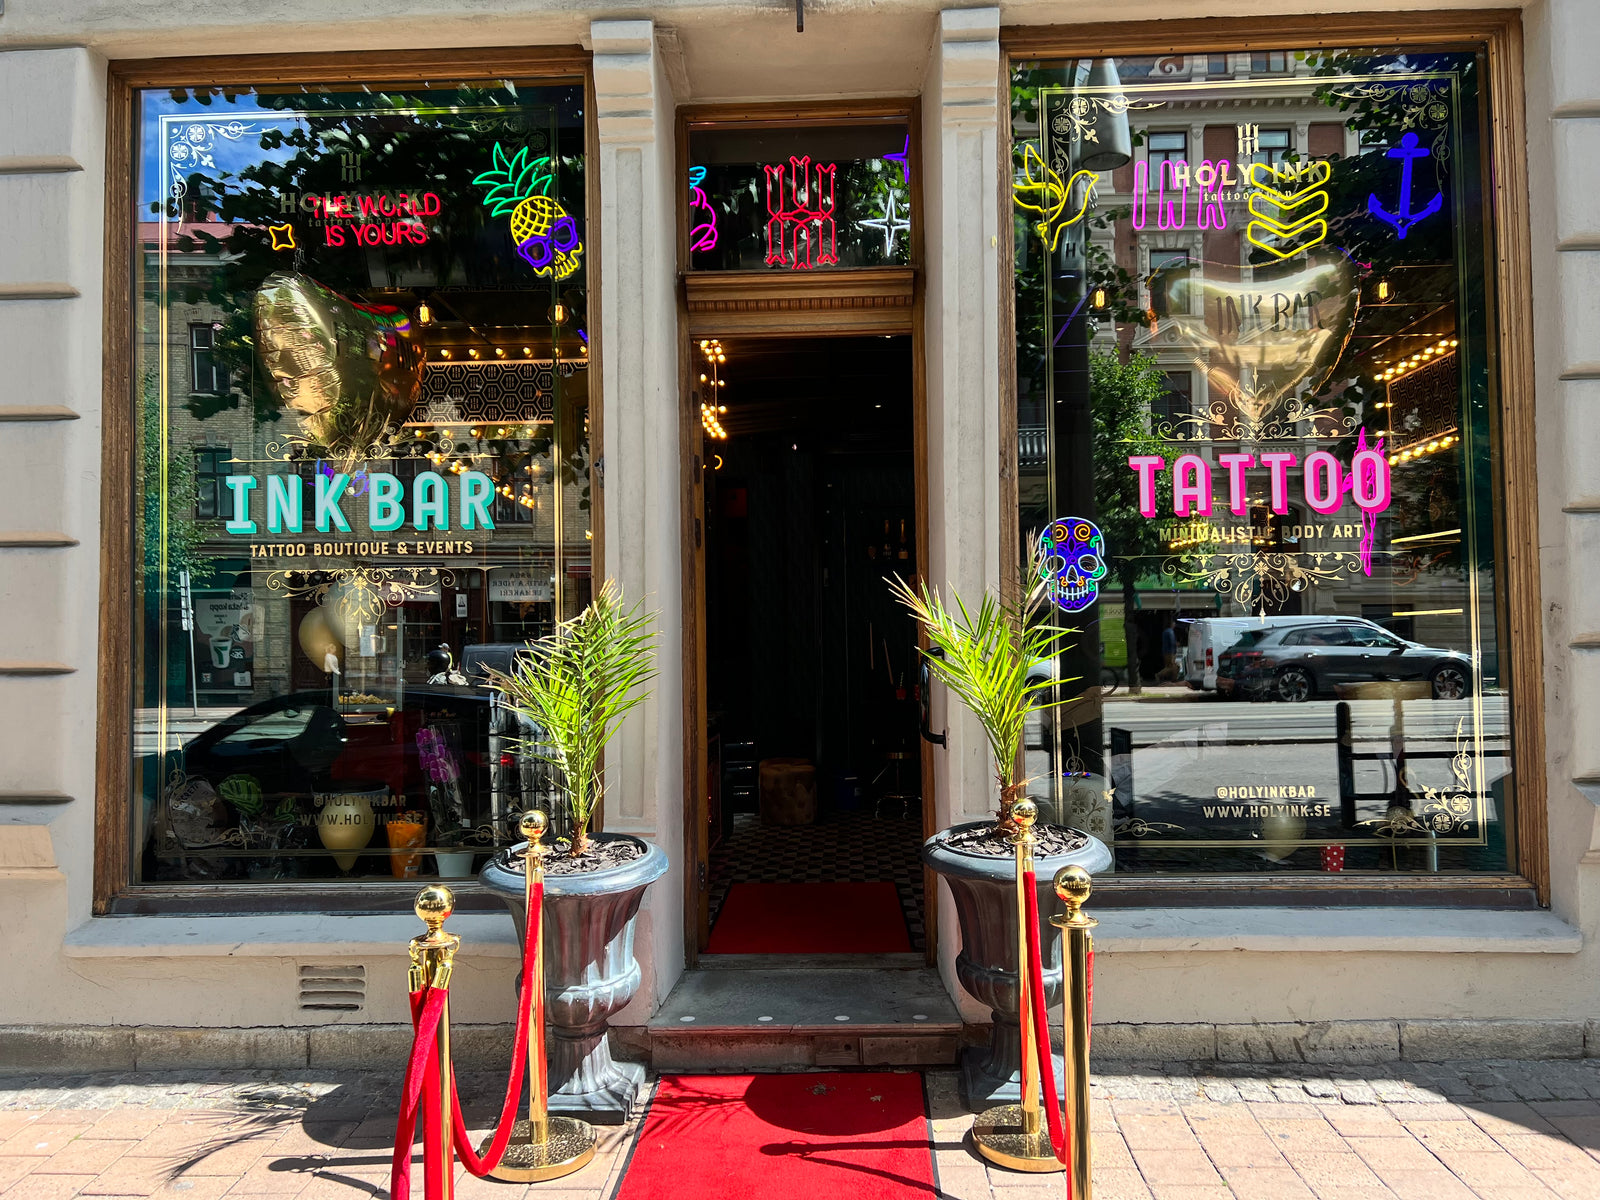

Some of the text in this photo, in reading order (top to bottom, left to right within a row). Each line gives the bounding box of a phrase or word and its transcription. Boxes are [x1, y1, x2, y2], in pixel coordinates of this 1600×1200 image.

[1174, 160, 1325, 188] HOLY INK
[307, 192, 441, 219] THE WORLD
[1133, 159, 1230, 230] INK
[1203, 190, 1250, 202] tattoo
[308, 216, 352, 228] tattoo
[325, 222, 428, 247] IS YOURS
[1216, 290, 1326, 336] INK BAR
[1128, 449, 1391, 518] TATTOO
[225, 470, 495, 535] INK BAR
[1158, 523, 1364, 542] MINIMALISTIC BODY ART
[249, 540, 474, 558] TATTOO BOUTIQUE & EVENTS
[1217, 785, 1316, 799] @HOLYINKBAR
[1202, 804, 1332, 818] WWW.HOLYINK.SE
